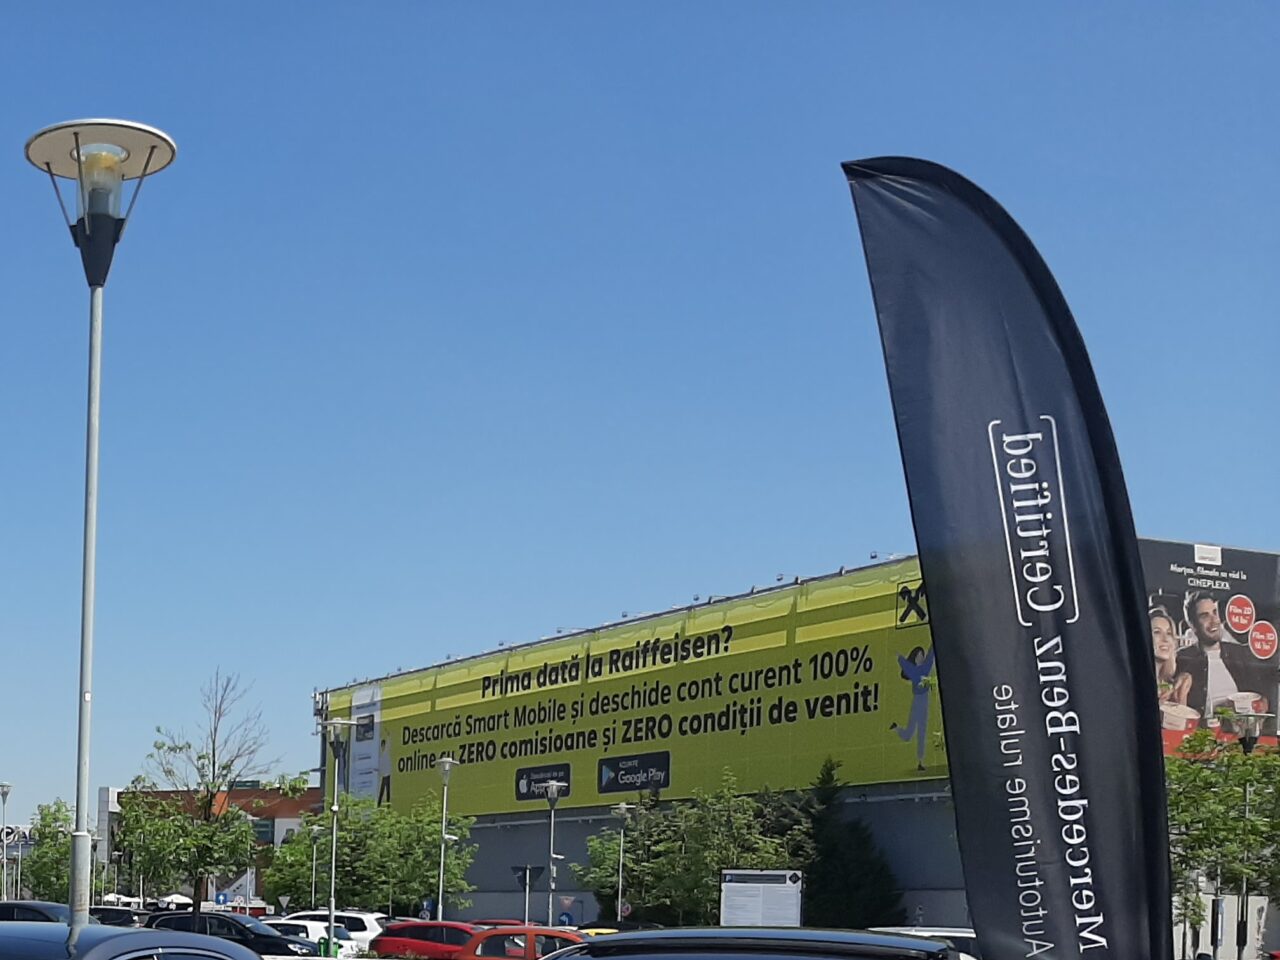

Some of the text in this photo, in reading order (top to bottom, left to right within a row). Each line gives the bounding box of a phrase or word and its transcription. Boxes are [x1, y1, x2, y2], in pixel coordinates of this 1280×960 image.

[401, 644, 873, 746] Descarcă Smart Mobile și deschide cont curent 100%
[481, 625, 734, 699] Prima dată la Raiffeisen?
[397, 748, 437, 773] online
[459, 739, 497, 765] ZERO
[500, 727, 598, 760] comisioane
[602, 719, 617, 753] și
[621, 713, 672, 744] ZERO
[677, 697, 762, 736] condiții
[768, 696, 798, 725] de
[805, 682, 880, 720] venit!
[617, 769, 647, 787] Google
